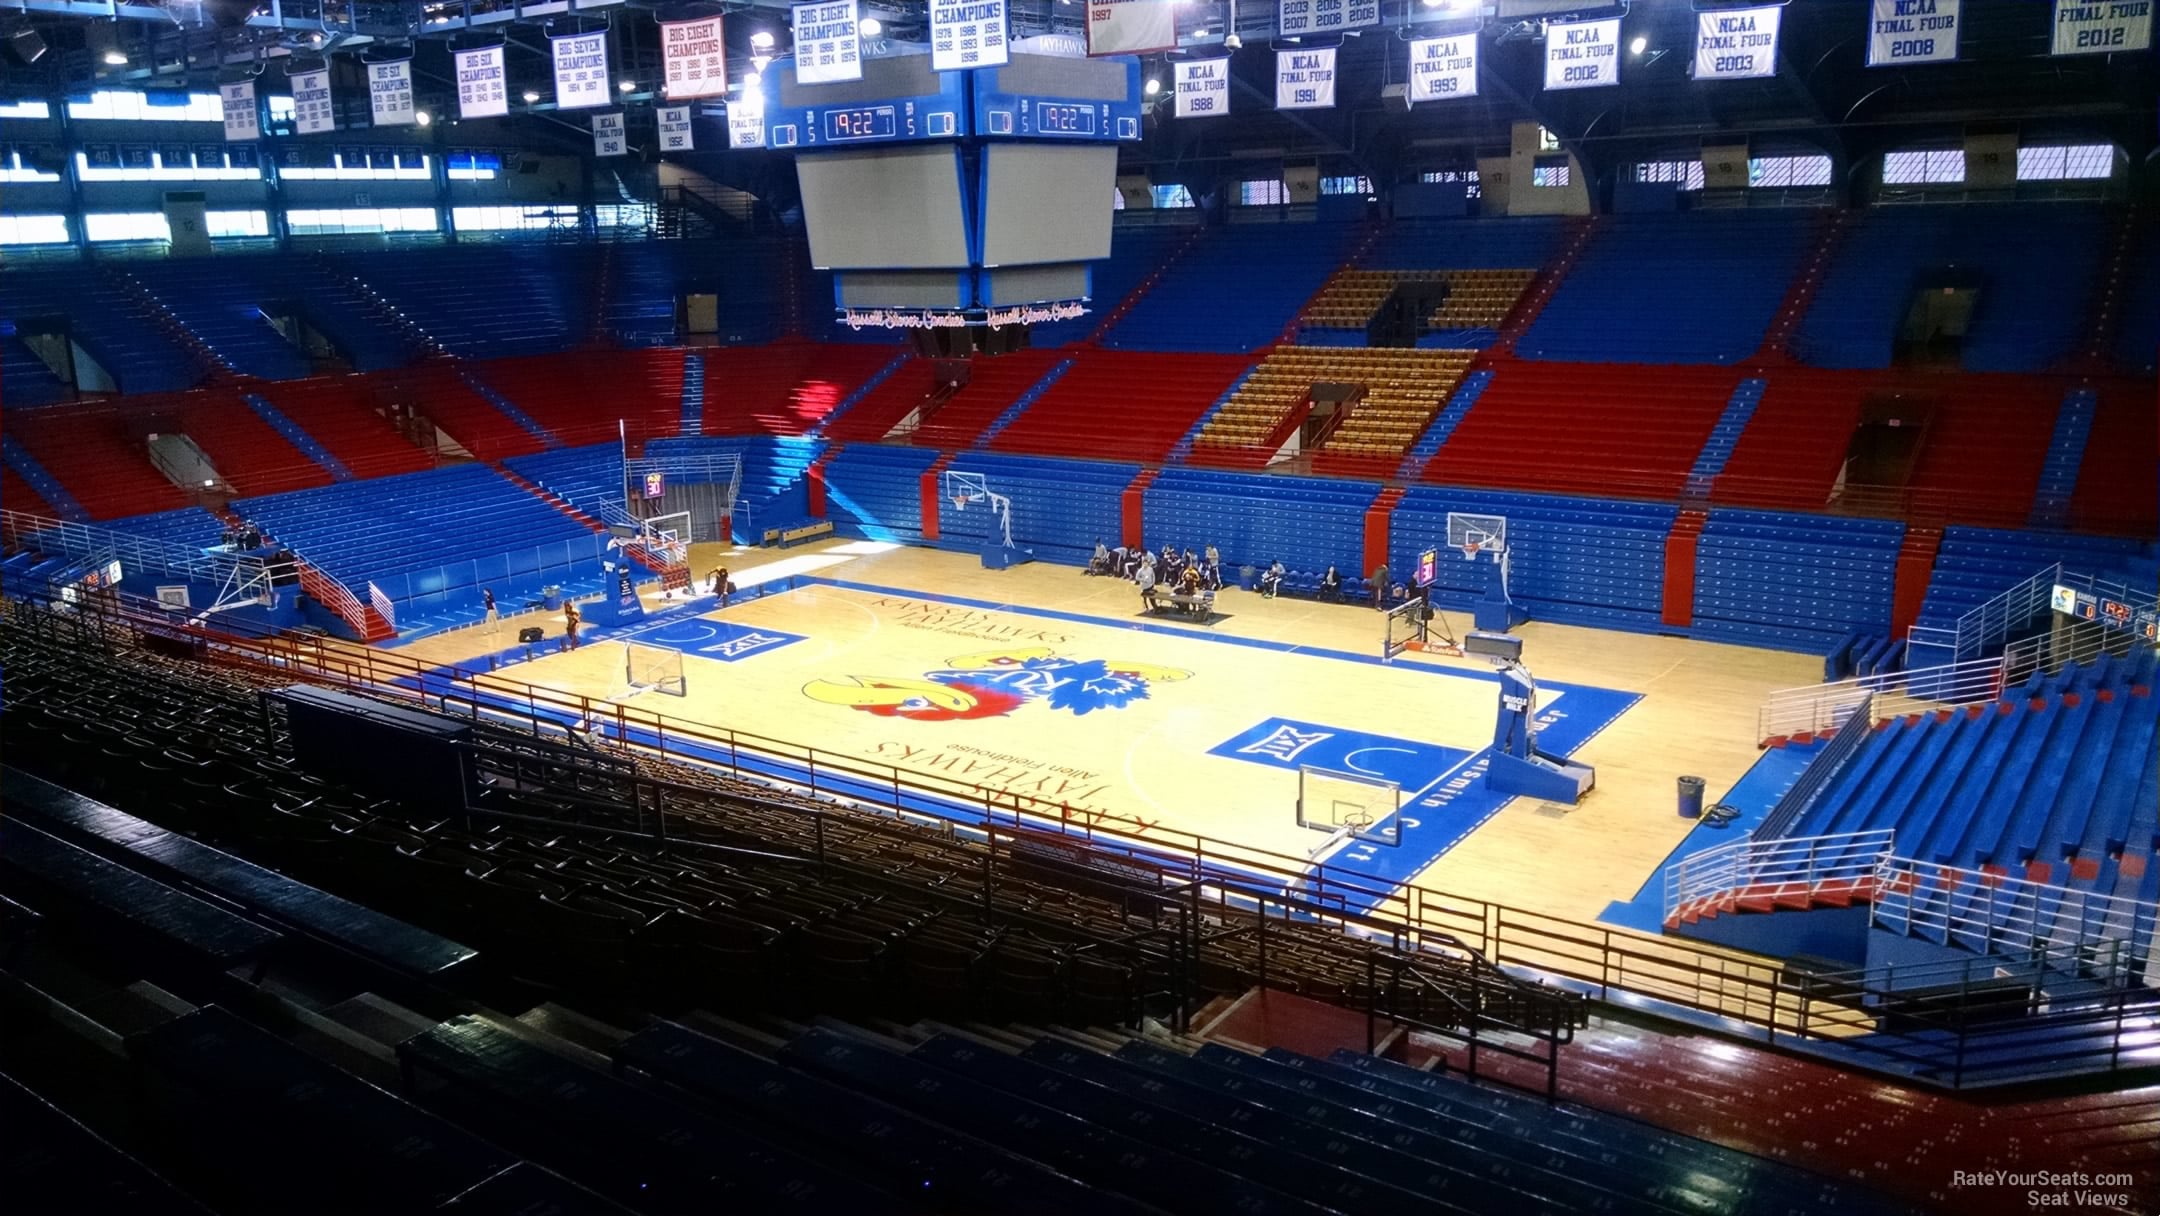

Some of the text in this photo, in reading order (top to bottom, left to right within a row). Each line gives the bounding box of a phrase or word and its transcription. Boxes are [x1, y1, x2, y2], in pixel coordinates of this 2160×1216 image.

[800, 4, 850, 24] BIG EIGHT
[935, 2, 1001, 25] CHAMPIONS
[1091, 9, 1112, 22] 1997
[1284, 0, 1342, 15] 2003 2005
[1894, 0, 1937, 17] NCAA
[2059, 2, 2149, 22] FINAL FOUR
[1284, 7, 1375, 30] 2007 2008 2009
[1718, 17, 1756, 33] NCAA
[1875, 15, 1955, 34] FINAL FOUR
[669, 23, 714, 42] BIG EIGHT
[798, 21, 855, 41] CHAMPIONS
[1565, 28, 1600, 45] NCAA
[2077, 27, 2124, 47] 2012
[558, 39, 600, 56] BIG SEVEN
[667, 39, 719, 58] CHAMPIONS
[1701, 33, 1772, 50] FINAL FOUR
[1891, 39, 1934, 58] 2008
[1427, 43, 1459, 58] NCAA
[1551, 44, 1615, 60] FINAL FOUR
[466, 53, 493, 68] BIG SIX
[557, 54, 603, 71] CHAMPIONS
[1292, 55, 1320, 70] NCAA
[1414, 57, 1473, 74] FINAL FOUR
[1715, 55, 1753, 72] 2003
[377, 66, 388, 79] BIG
[460, 66, 501, 82] CHAMPIONS
[1188, 65, 1214, 79] NCAA
[1280, 70, 1332, 83] FINAL FOUR
[1564, 65, 1599, 82] 2002
[372, 79, 409, 92] CHAMPIONS
[1178, 79, 1225, 93] FINAL FOUR
[1429, 77, 1458, 94] 1993
[1190, 97, 1213, 112] 1988
[1294, 89, 1317, 103] 1991
[846, 308, 965, 331] Russell Stover Candies
[987, 307, 1019, 331] Russell
[1021, 305, 1051, 325] Stover
[2086, 606, 2094, 618] 0
[894, 612, 1076, 644] JAYHAWKS
[2146, 623, 2155, 639] 0
[1503, 695, 1527, 706] MUSCLE
[1506, 703, 1523, 712] MILK
[946, 743, 1100, 780] Allen Fieldhouse
[867, 741, 1111, 800] JAYHAWKS
[1419, 755, 1491, 808] aismith
[1347, 817, 1421, 861] Cort
